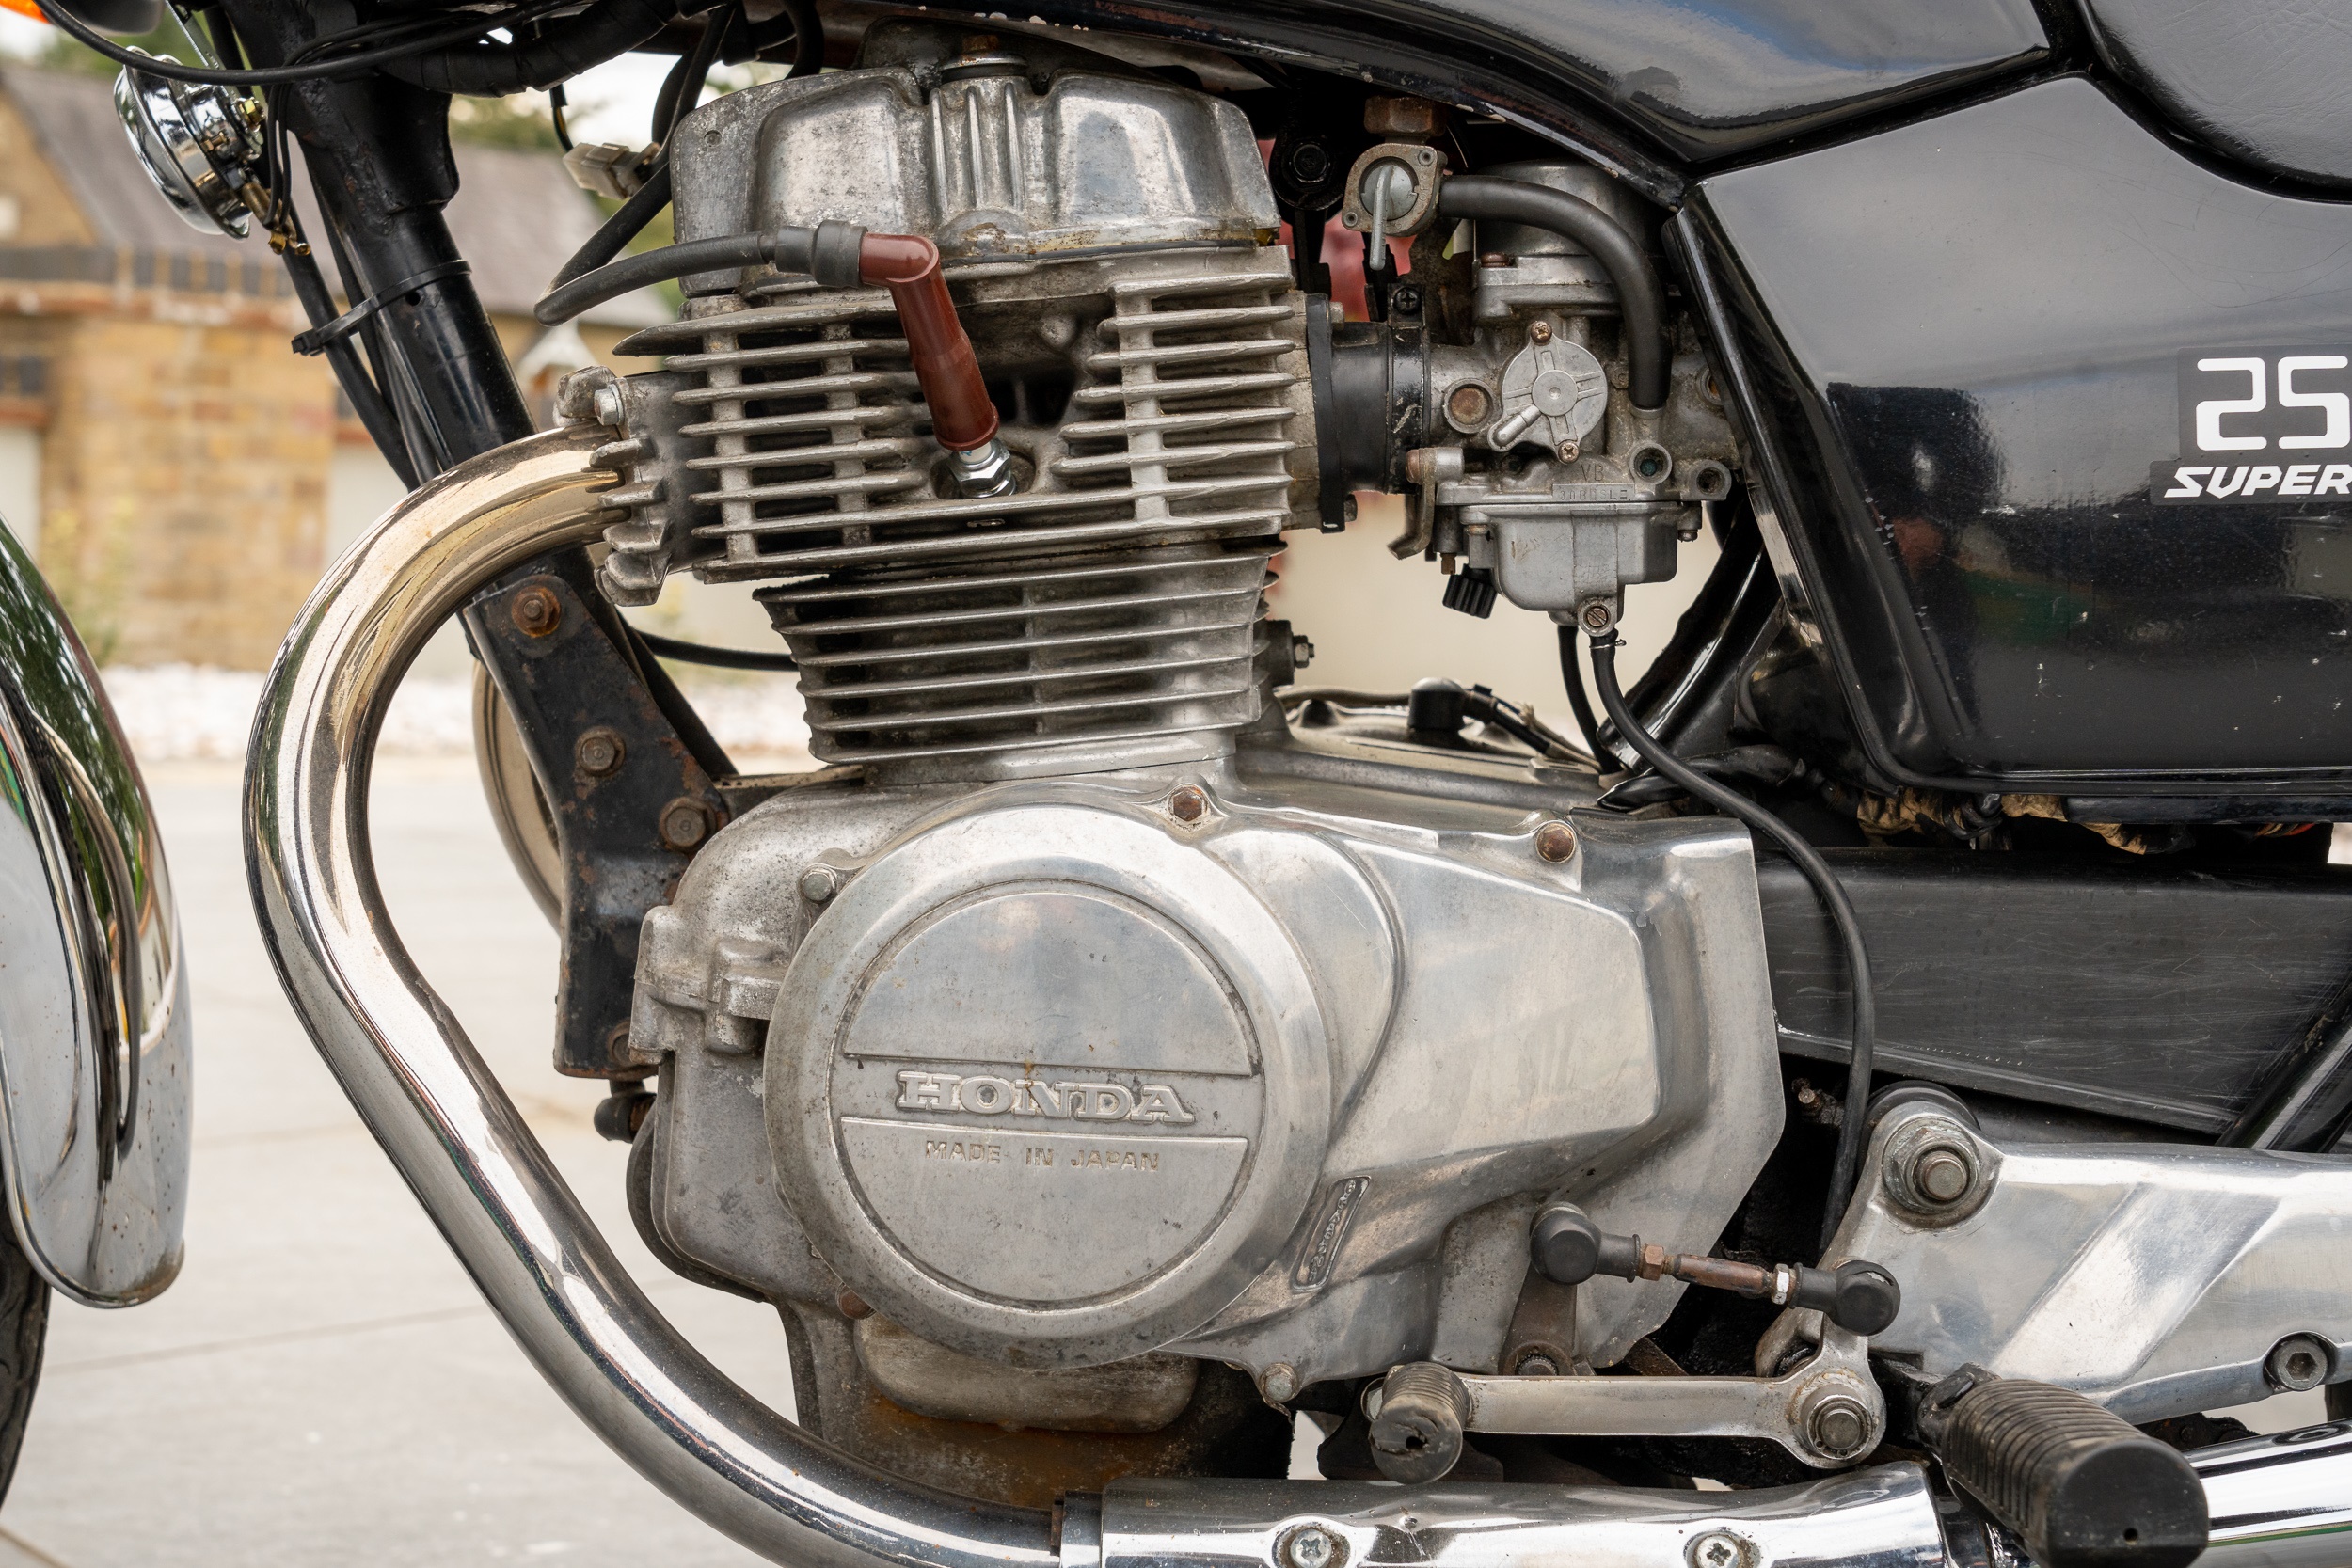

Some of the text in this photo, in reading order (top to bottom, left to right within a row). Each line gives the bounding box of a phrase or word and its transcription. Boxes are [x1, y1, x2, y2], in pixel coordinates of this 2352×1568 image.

[2195, 355, 2351, 451] 25
[1581, 464, 1604, 481] VB
[2164, 464, 2352, 499] SUPER
[897, 1071, 1195, 1124] HONDA
[926, 1140, 1160, 1172] MADE IN JAPAN
